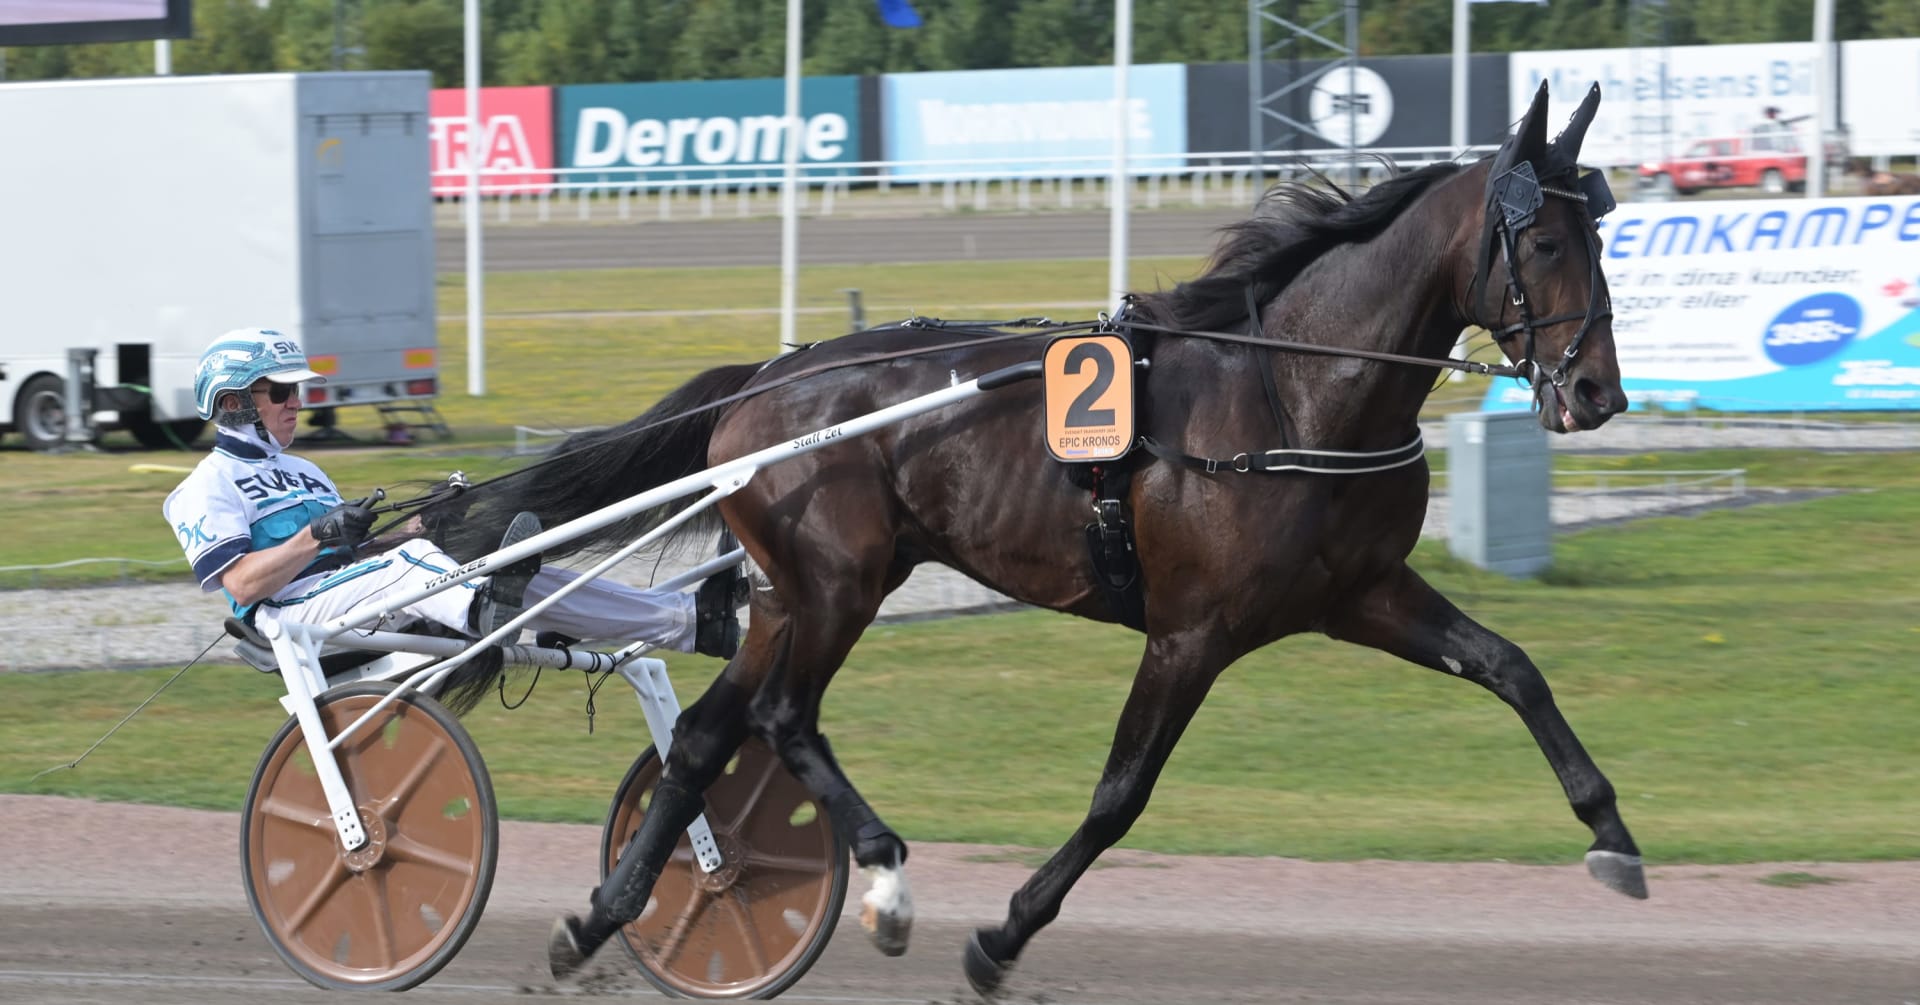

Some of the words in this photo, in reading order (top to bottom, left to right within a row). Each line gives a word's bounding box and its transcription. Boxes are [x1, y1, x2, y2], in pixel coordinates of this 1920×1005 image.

[573, 107, 848, 167] Derome
[1601, 202, 1920, 259] EMKAMPE
[1063, 341, 1116, 429] 2
[793, 431, 820, 449] Stall
[1059, 437, 1080, 448] EPIC
[1082, 435, 1120, 447] KRONOS
[425, 557, 488, 589] YANKEE
